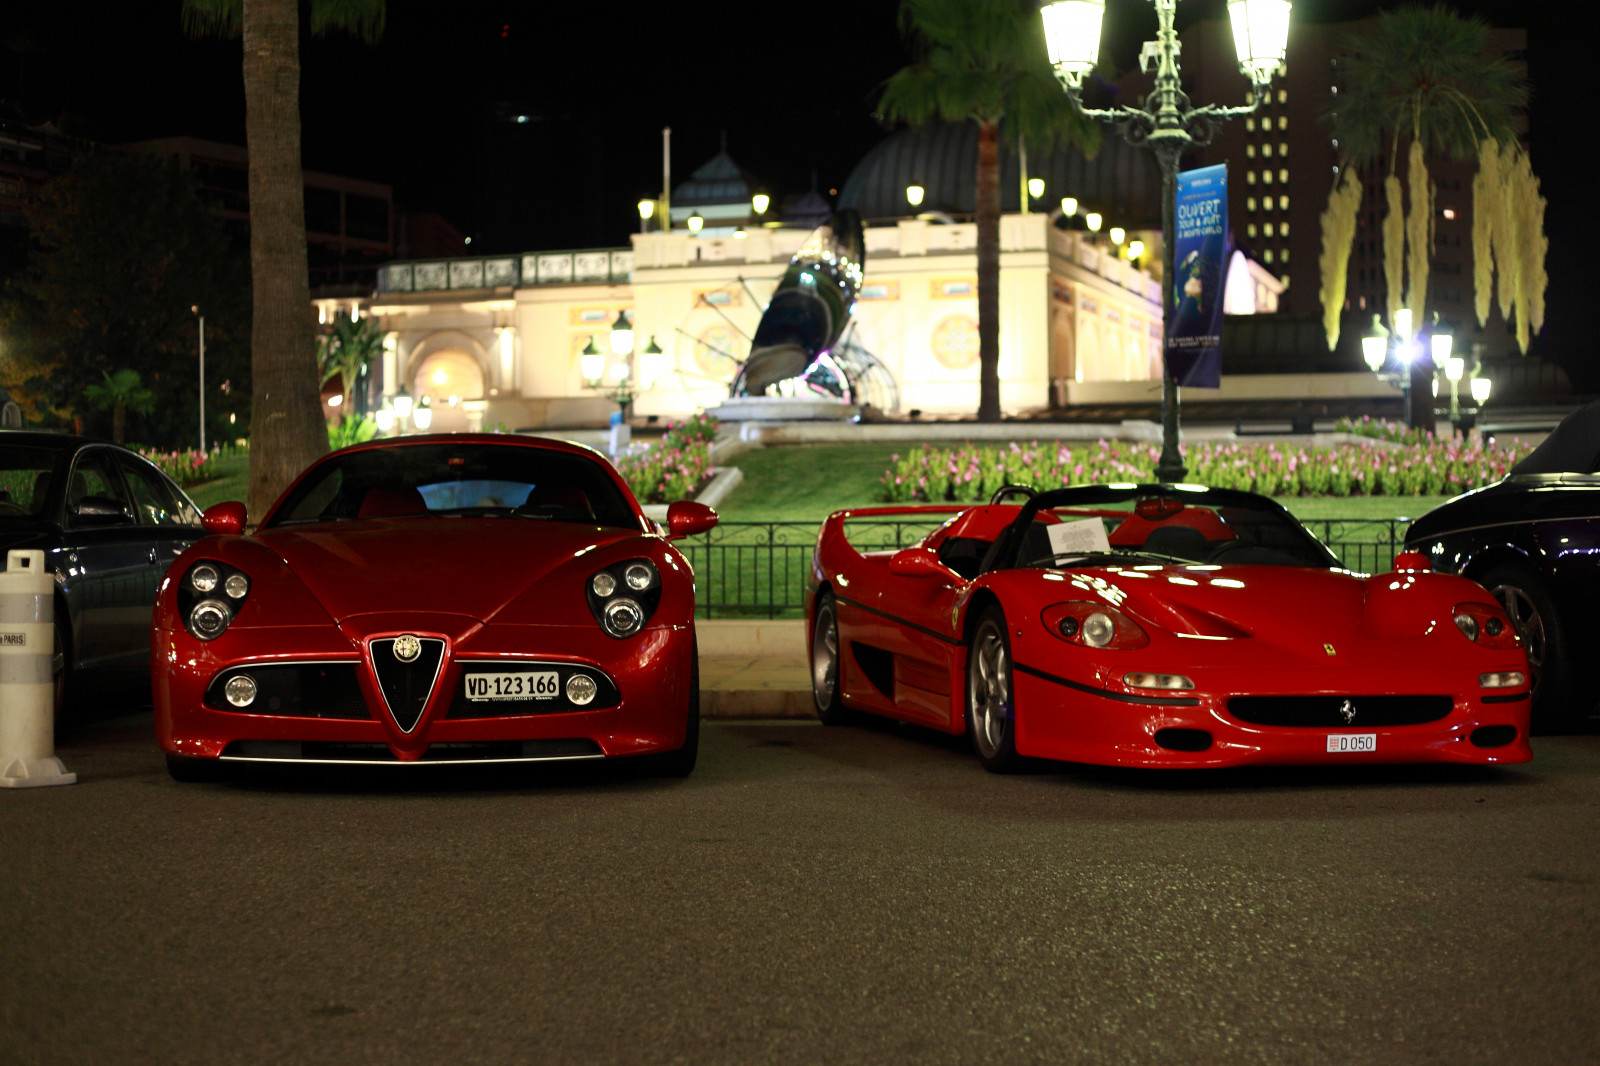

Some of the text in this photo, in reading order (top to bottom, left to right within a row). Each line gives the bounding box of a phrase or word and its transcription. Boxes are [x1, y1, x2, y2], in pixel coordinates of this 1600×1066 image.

[1178, 199, 1220, 219] OUVERT
[4, 635, 24, 644] PARIS
[527, 675, 556, 694] 166
[1340, 736, 1373, 750] D 050
